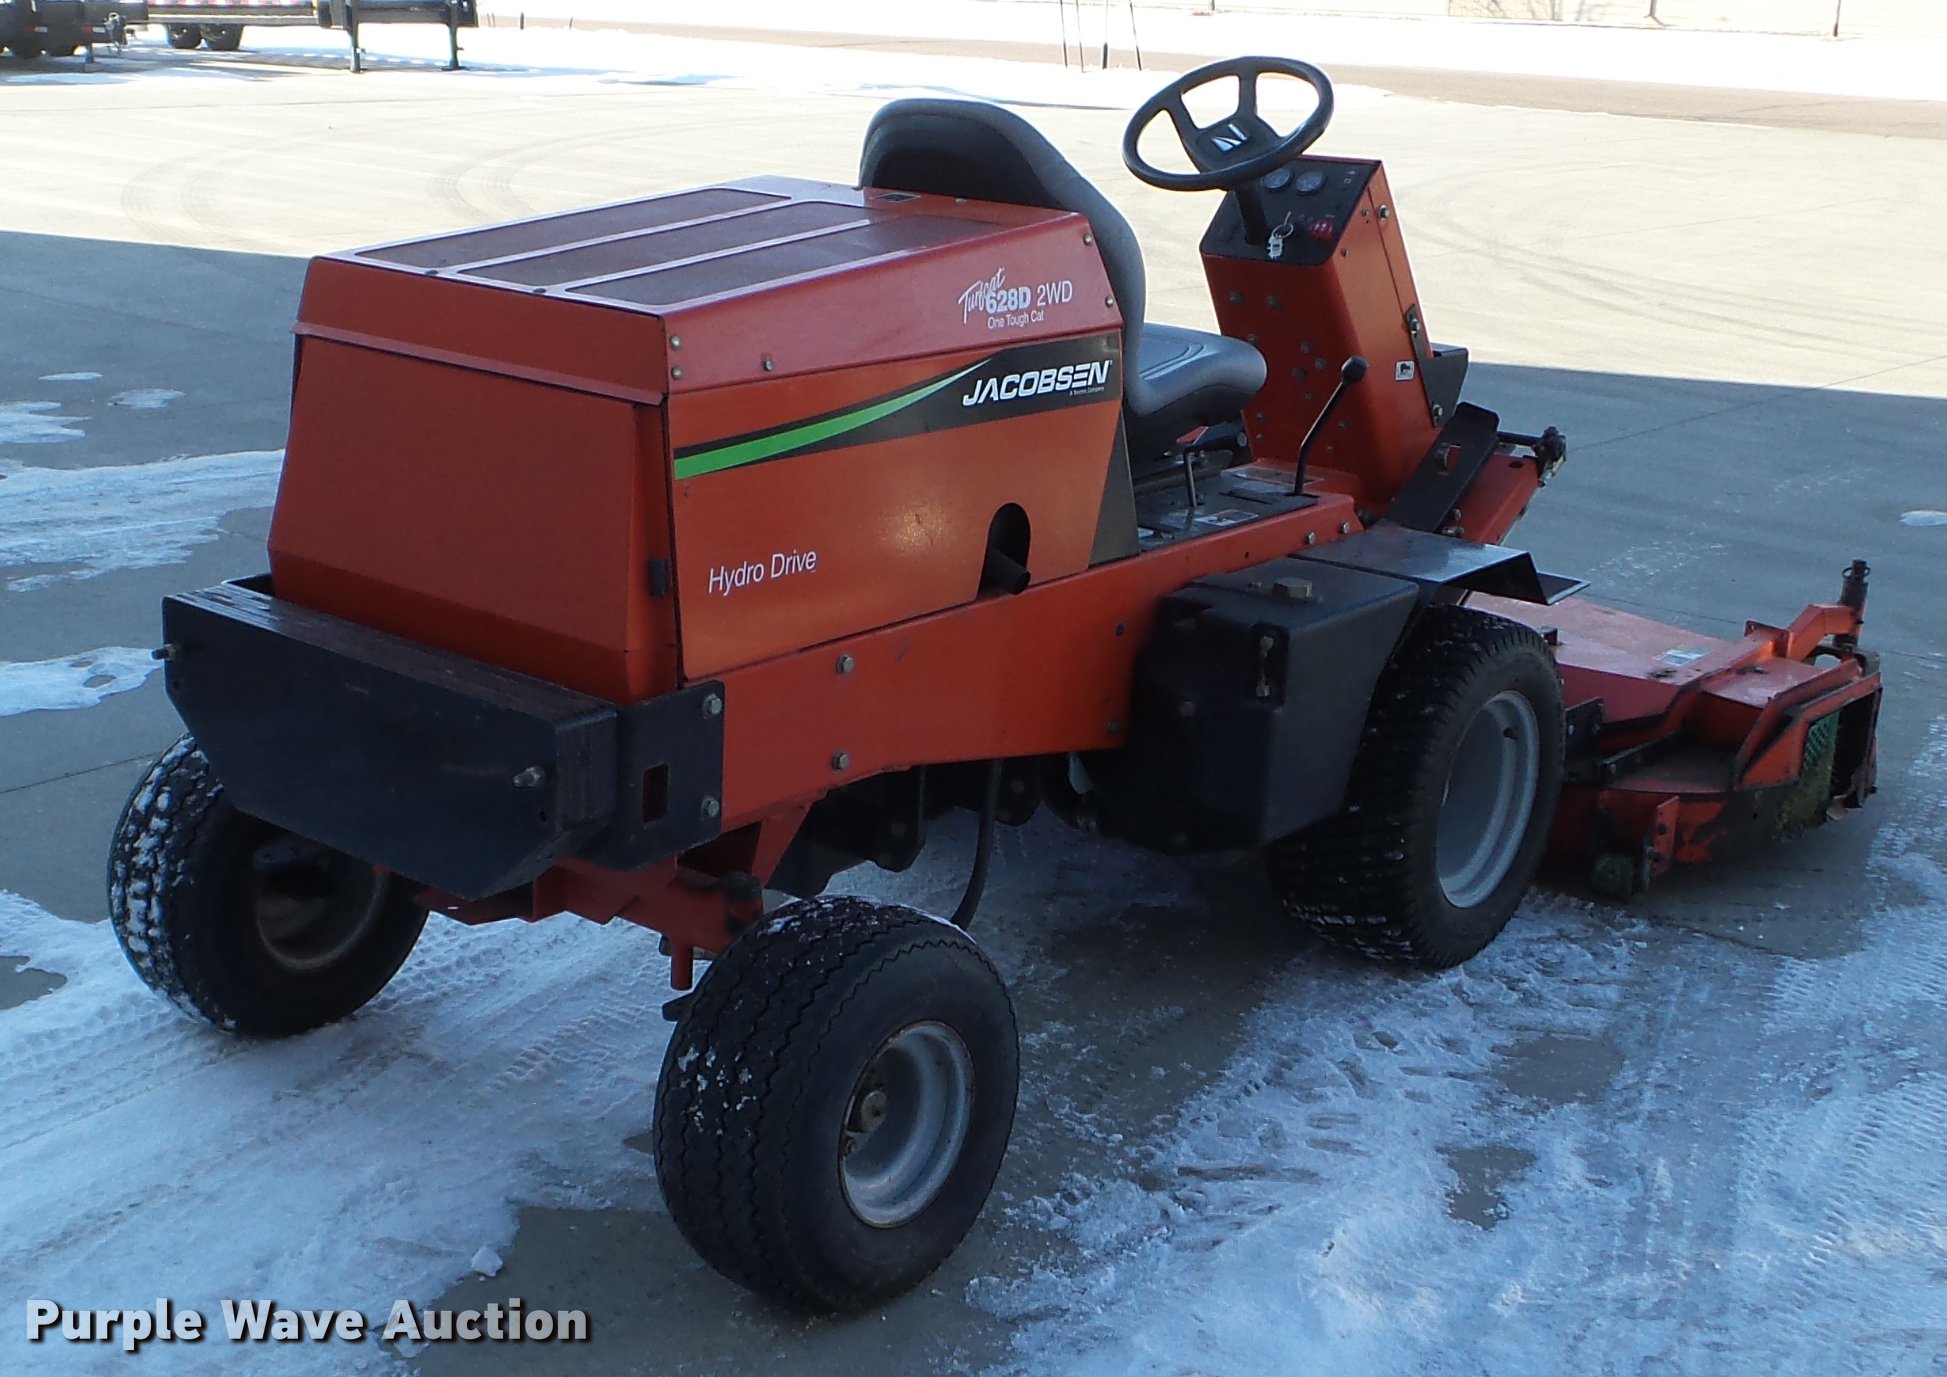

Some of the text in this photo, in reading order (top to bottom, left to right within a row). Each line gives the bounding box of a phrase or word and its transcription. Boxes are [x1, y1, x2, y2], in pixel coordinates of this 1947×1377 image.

[958, 267, 1005, 324] Turfcat
[985, 280, 1073, 314] 628D 2WD
[987, 309, 1044, 329] One Tough Cat
[962, 360, 1110, 406] JACOBSEN
[708, 549, 817, 596] Hydro Drive
